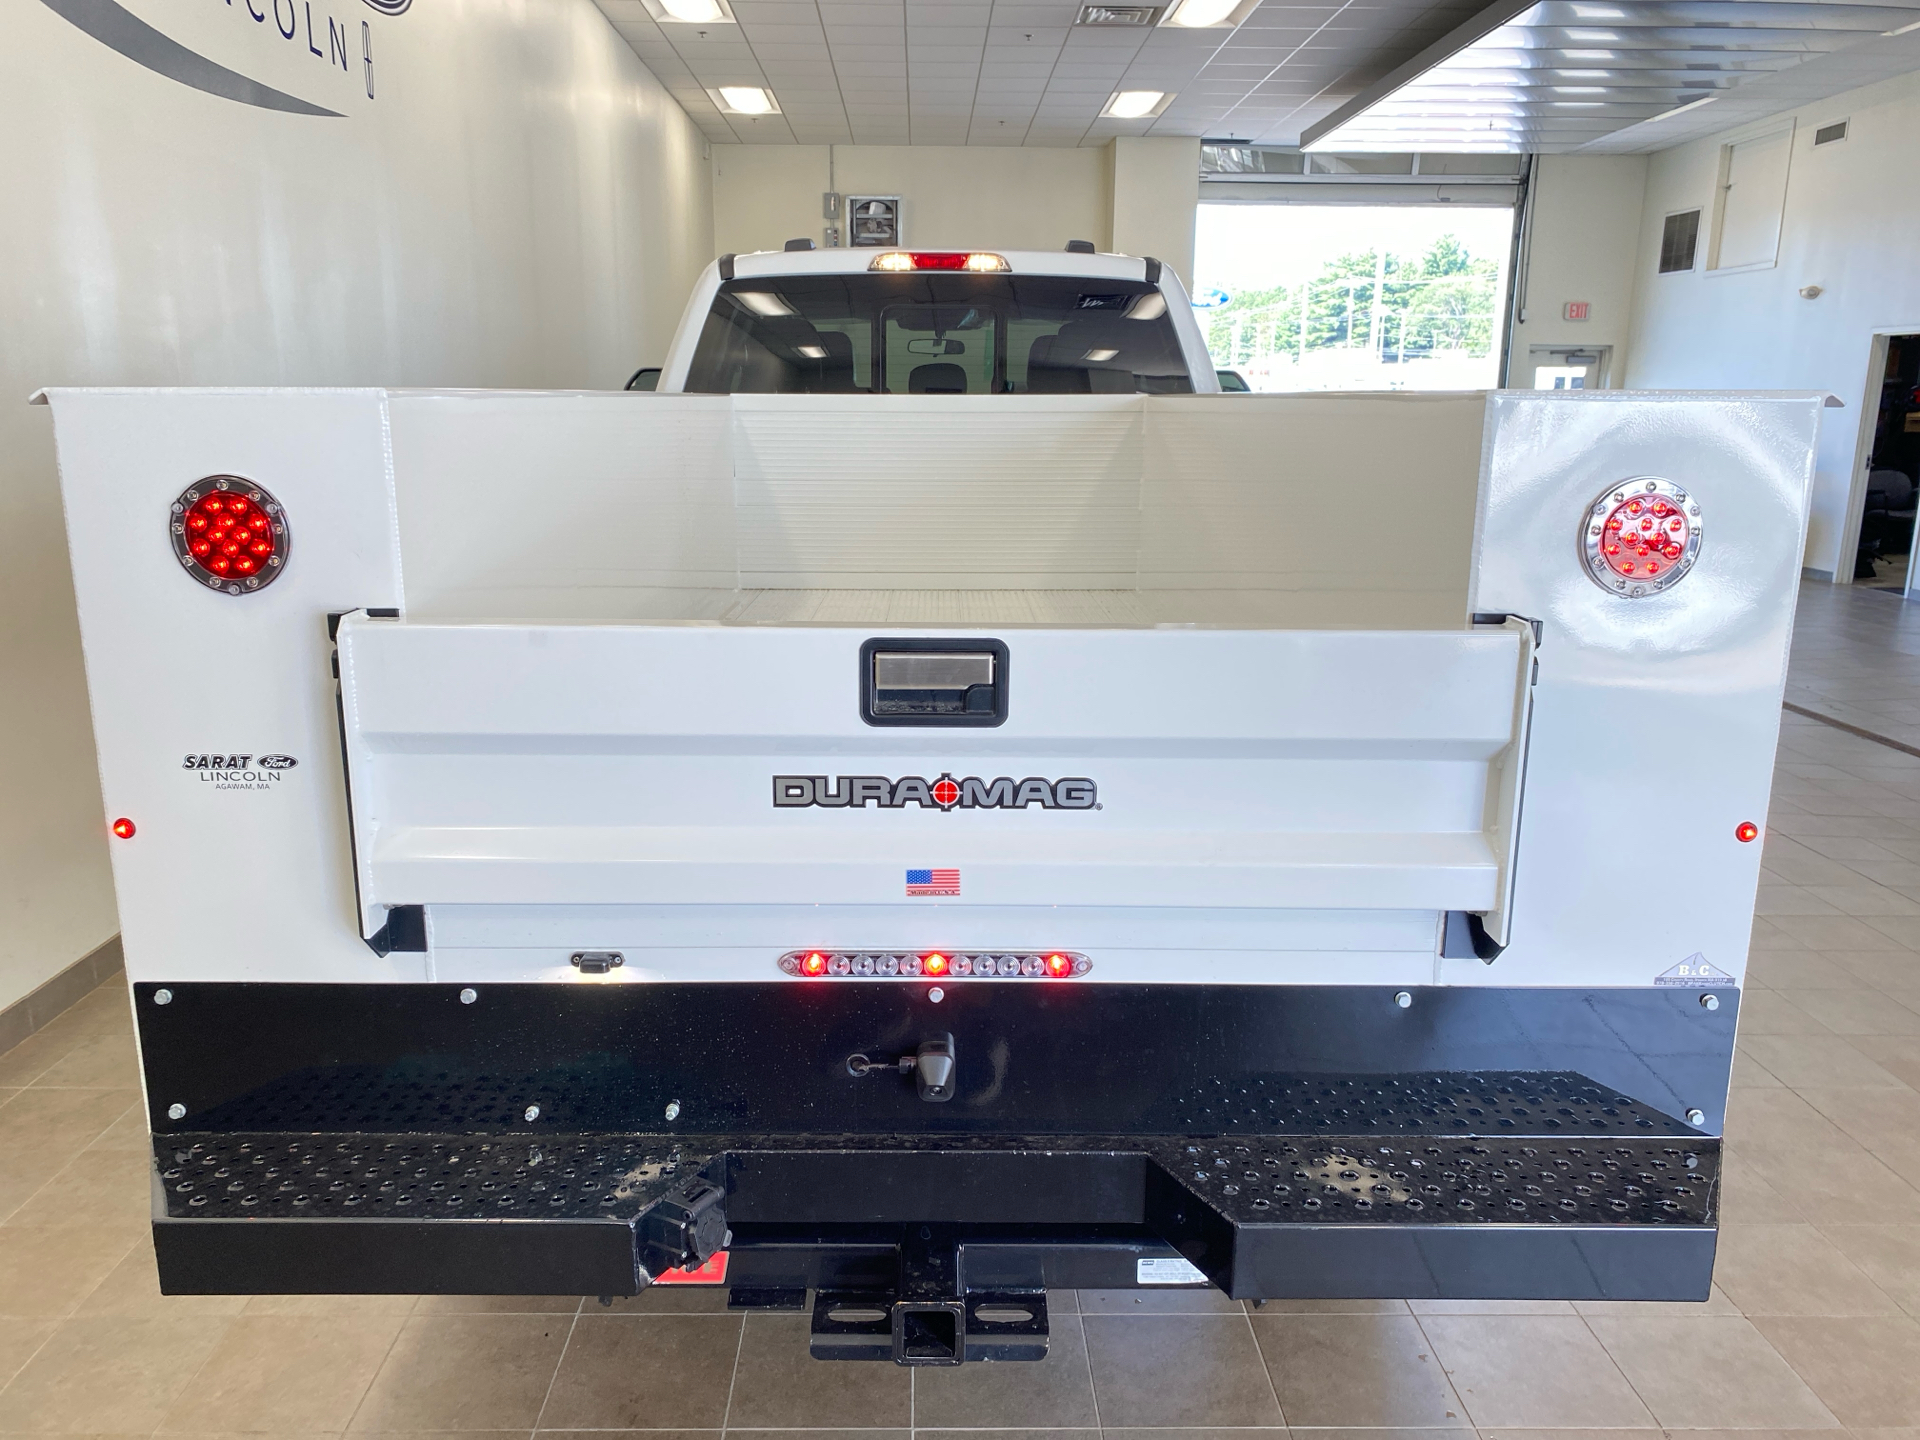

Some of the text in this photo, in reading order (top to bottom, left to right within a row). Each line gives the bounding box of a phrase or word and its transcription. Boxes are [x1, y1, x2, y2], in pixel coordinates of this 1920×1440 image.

[1569, 303, 1589, 319] EXIT
[182, 754, 293, 770] SARAT Ford
[200, 771, 281, 782] LINCOLN
[215, 783, 256, 791] AGAWAM,
